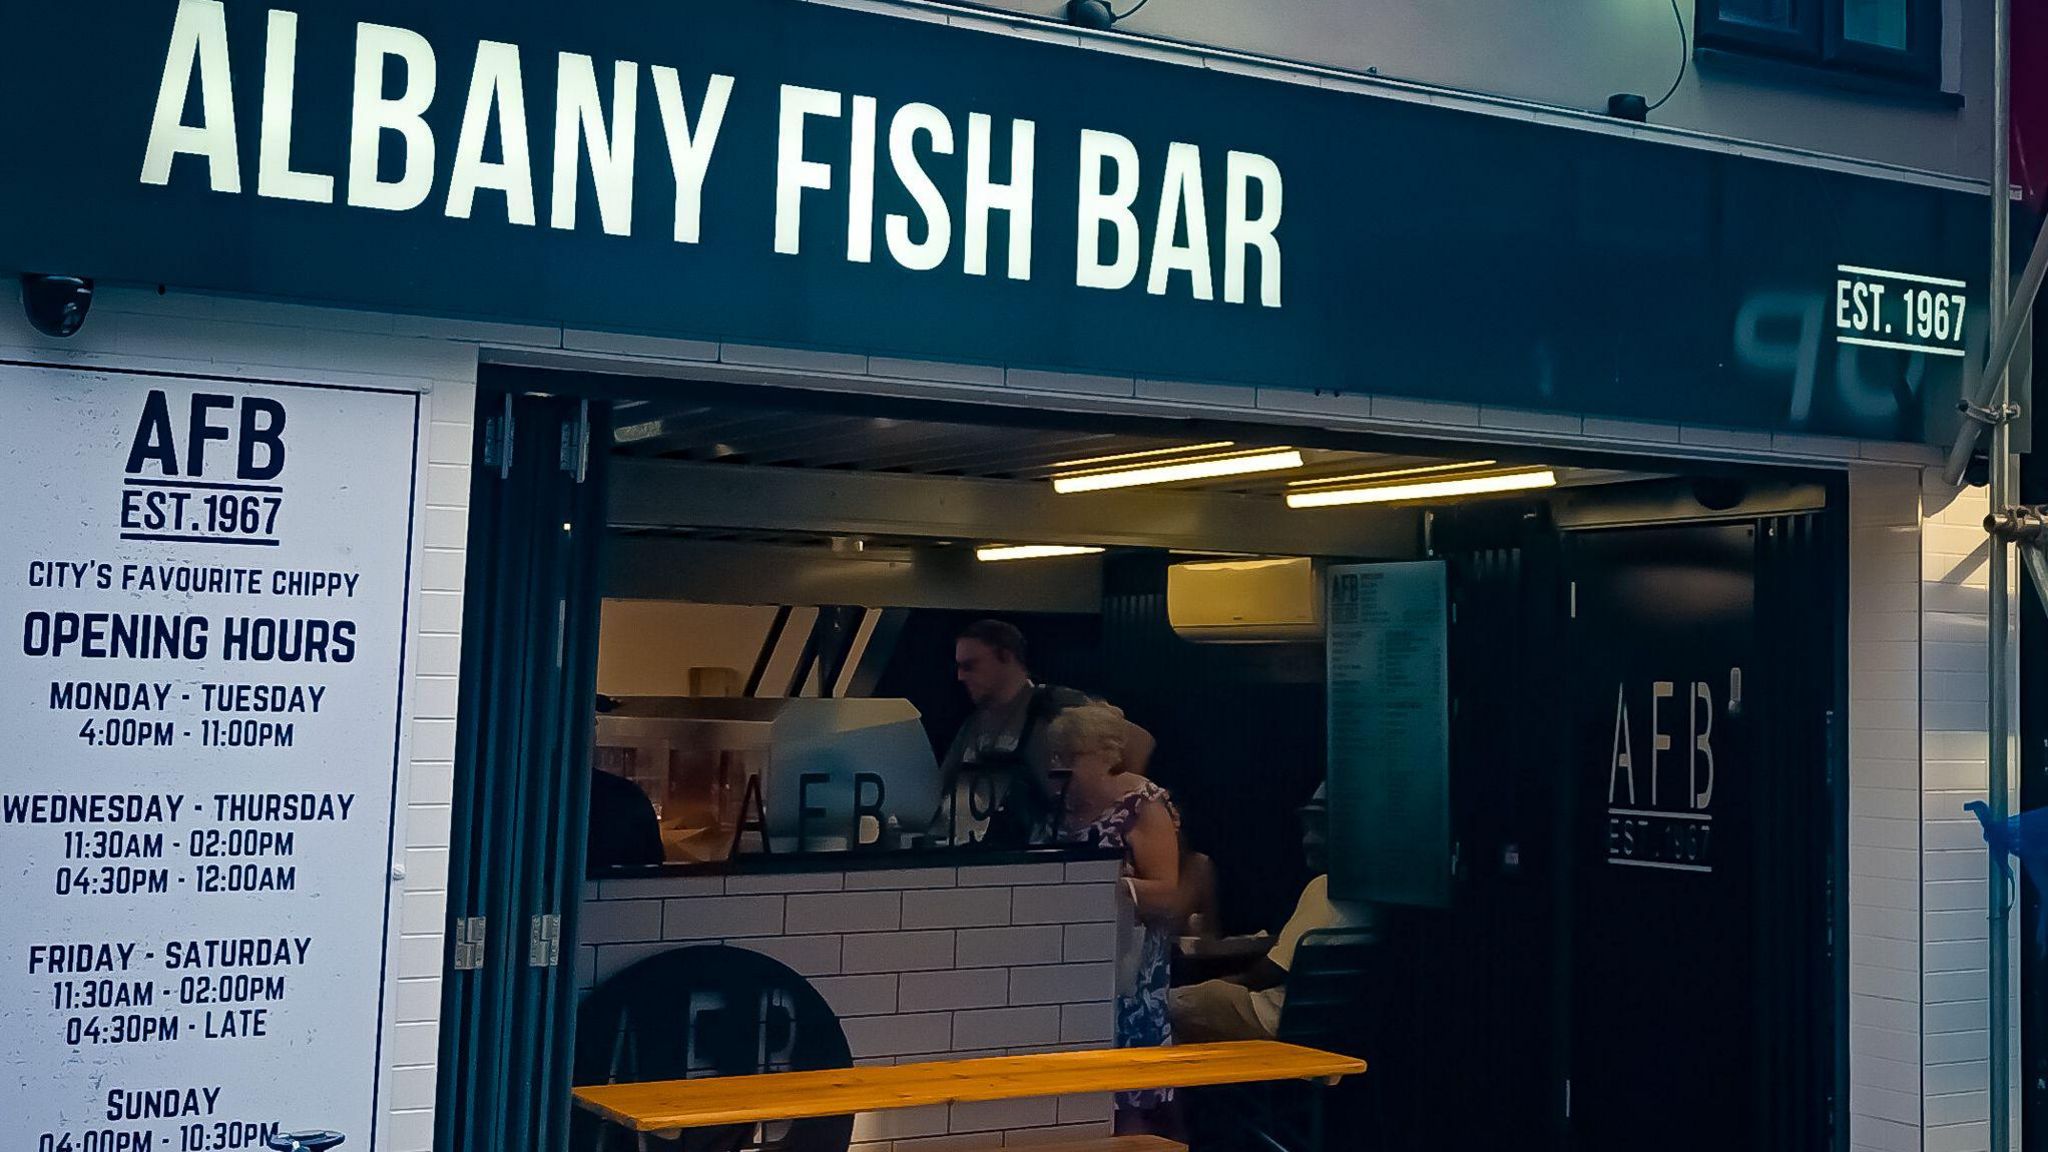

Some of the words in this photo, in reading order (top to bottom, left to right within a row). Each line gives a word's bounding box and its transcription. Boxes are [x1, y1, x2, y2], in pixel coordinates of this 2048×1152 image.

[140, 0, 734, 243] ALBANY
[775, 84, 1035, 280] FISH
[1077, 129, 1282, 307] BAR
[1837, 280, 1891, 333] EST.
[1904, 288, 1966, 341] 1967
[124, 390, 287, 480] AFB
[30, 560, 112, 589] CITY'S
[122, 565, 262, 593] FAVOURITE
[273, 571, 359, 597] CHIPPY
[24, 612, 208, 659] OPENING
[223, 618, 355, 662] HOURS
[50, 682, 171, 710] MONDAY
[202, 684, 325, 712] TUESDAY
[79, 719, 173, 745] 4:00PM
[202, 720, 293, 746] 11:00PM
[1608, 681, 1714, 810] AFB
[4, 795, 183, 823] WEDNESDAY
[214, 794, 354, 821] THURSDAY
[731, 772, 888, 855] AFB
[65, 831, 162, 858] 11:30AM
[190, 830, 293, 856] 02:00PM
[56, 867, 168, 895] 04:30PM
[197, 864, 295, 892] 12:00AM
[29, 943, 135, 974] FRIDAY
[166, 938, 311, 968] SATURDAY
[54, 980, 153, 1009] 11:30AM
[181, 975, 284, 1004] 02:00PM
[67, 1015, 178, 1045] 04:30PM
[205, 1009, 267, 1038] LATE
[107, 1087, 220, 1121] SUNDAY
[180, 1122, 280, 1149] 10:30PM
